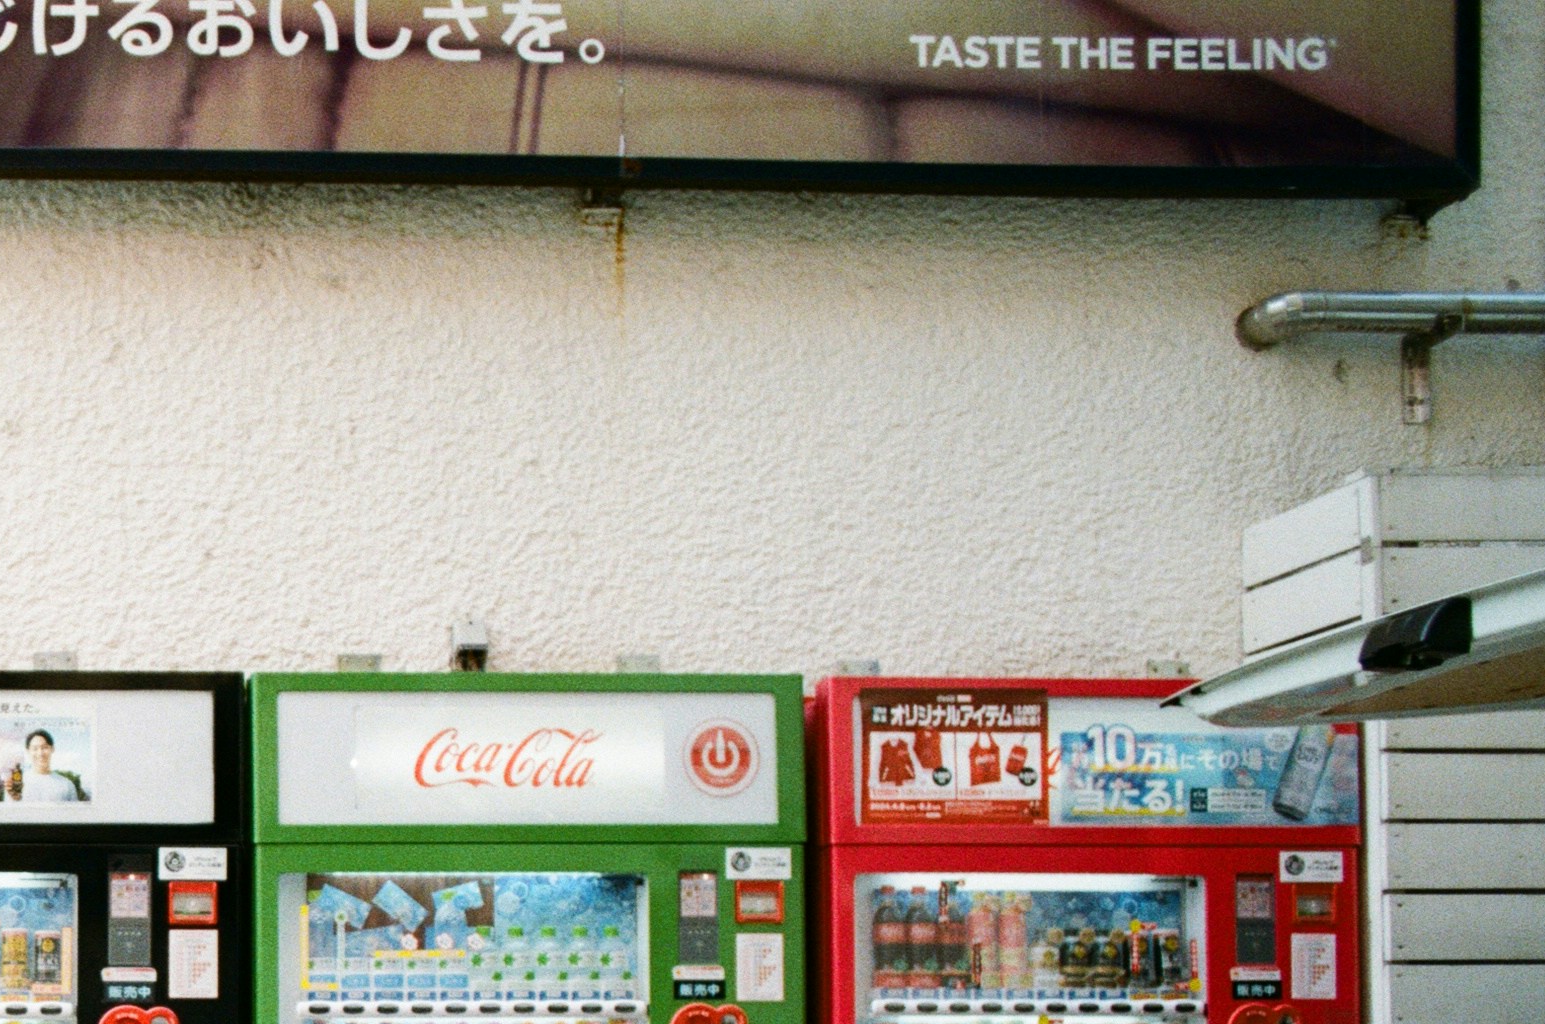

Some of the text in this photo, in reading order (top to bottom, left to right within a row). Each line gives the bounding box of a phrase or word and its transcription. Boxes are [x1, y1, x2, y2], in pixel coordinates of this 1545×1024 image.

[909, 35, 1328, 71] TASTE THE FEELING
[890, 703, 1013, 728] オリジナルアイテム
[413, 726, 604, 789] Coca-Cola
